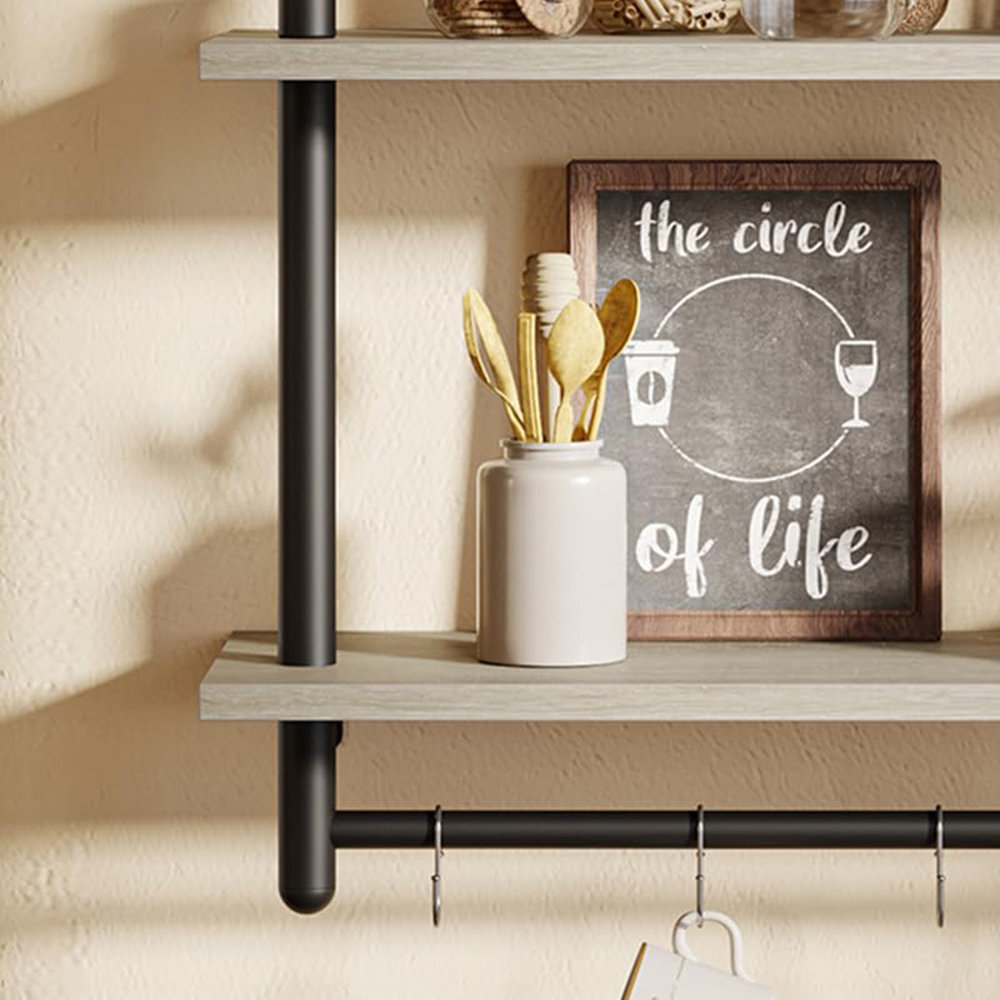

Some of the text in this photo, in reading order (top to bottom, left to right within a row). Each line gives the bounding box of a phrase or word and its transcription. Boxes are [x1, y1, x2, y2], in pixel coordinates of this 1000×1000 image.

[634, 199, 872, 263] the circle
[636, 494, 872, 599] of life
